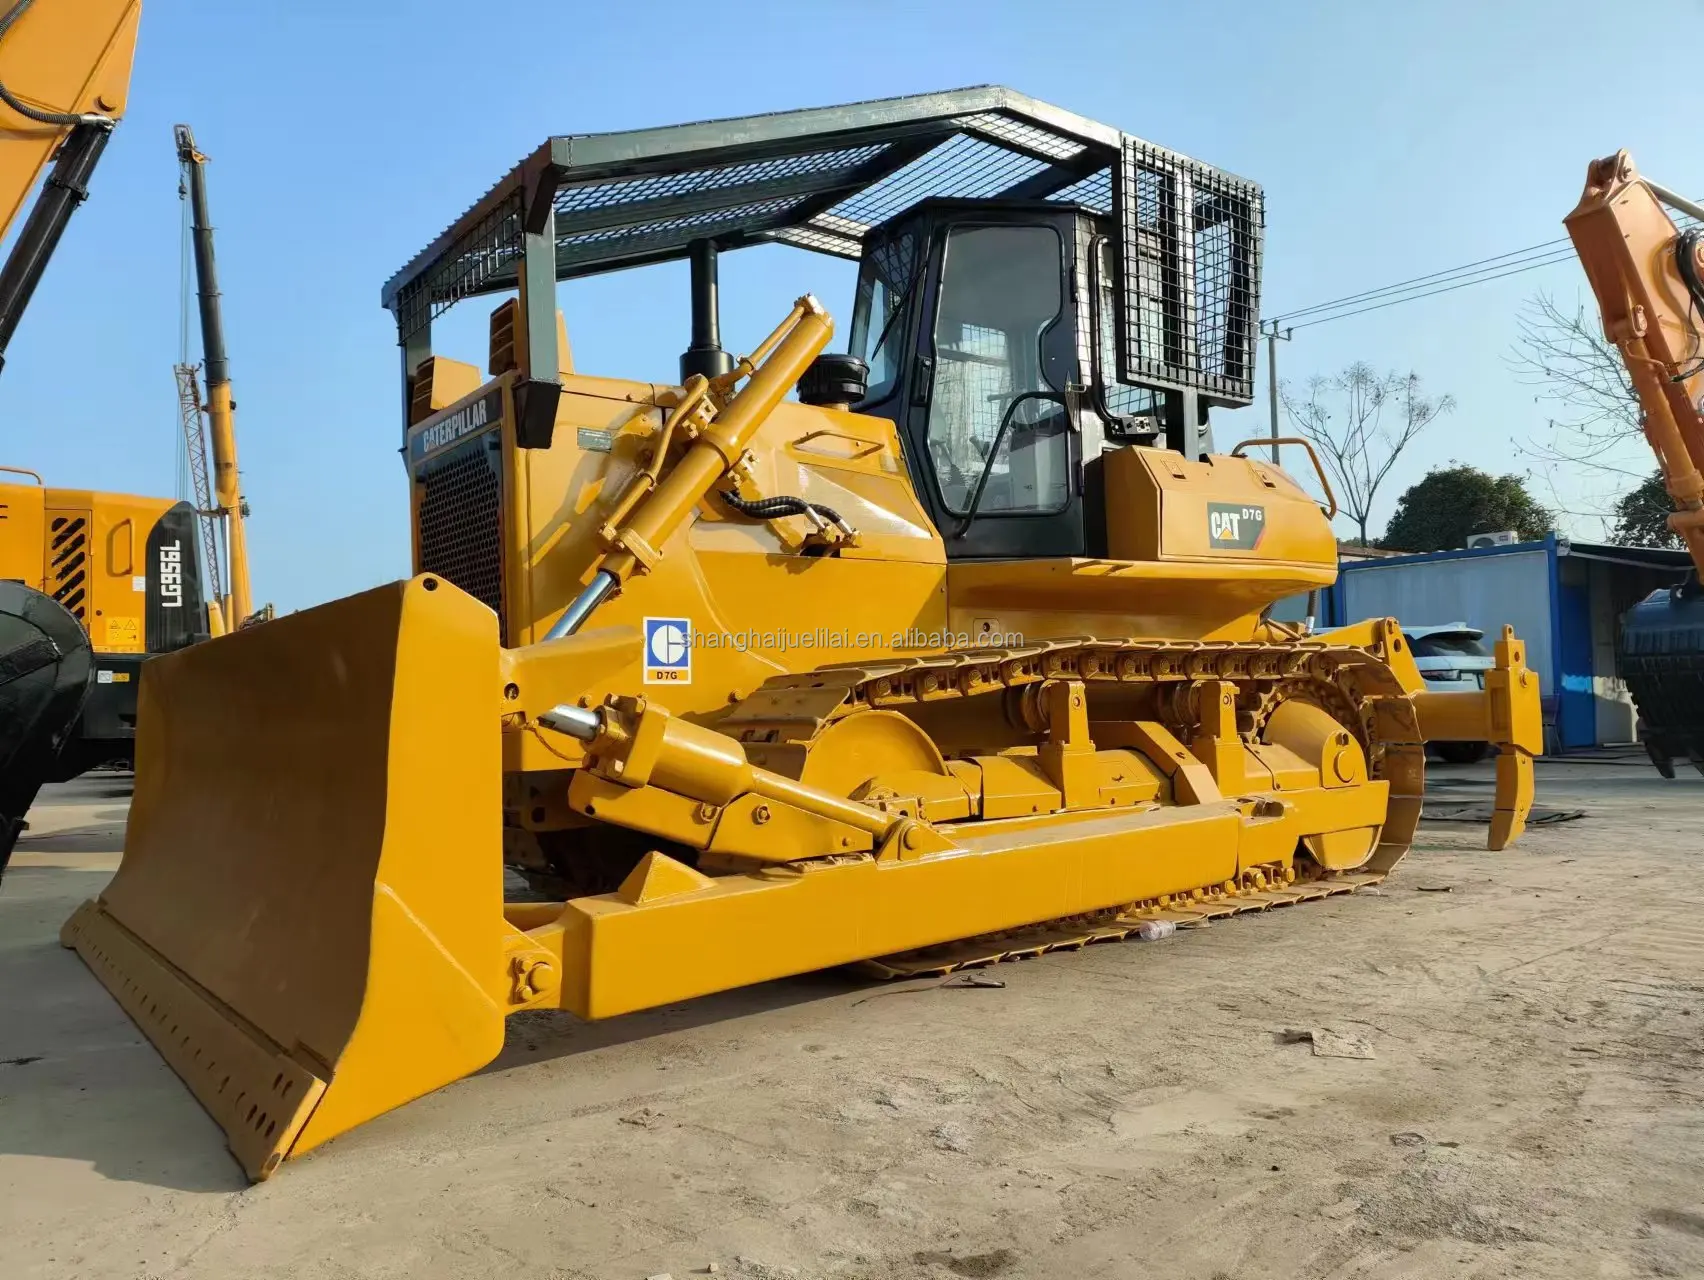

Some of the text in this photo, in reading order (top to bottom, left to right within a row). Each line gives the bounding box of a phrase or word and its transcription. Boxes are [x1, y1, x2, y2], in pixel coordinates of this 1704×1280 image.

[423, 399, 487, 453] CATERPILLAR
[1210, 508, 1263, 541] CAT D7G
[160, 540, 182, 608] LG956L
[656, 671, 678, 680] D7G
